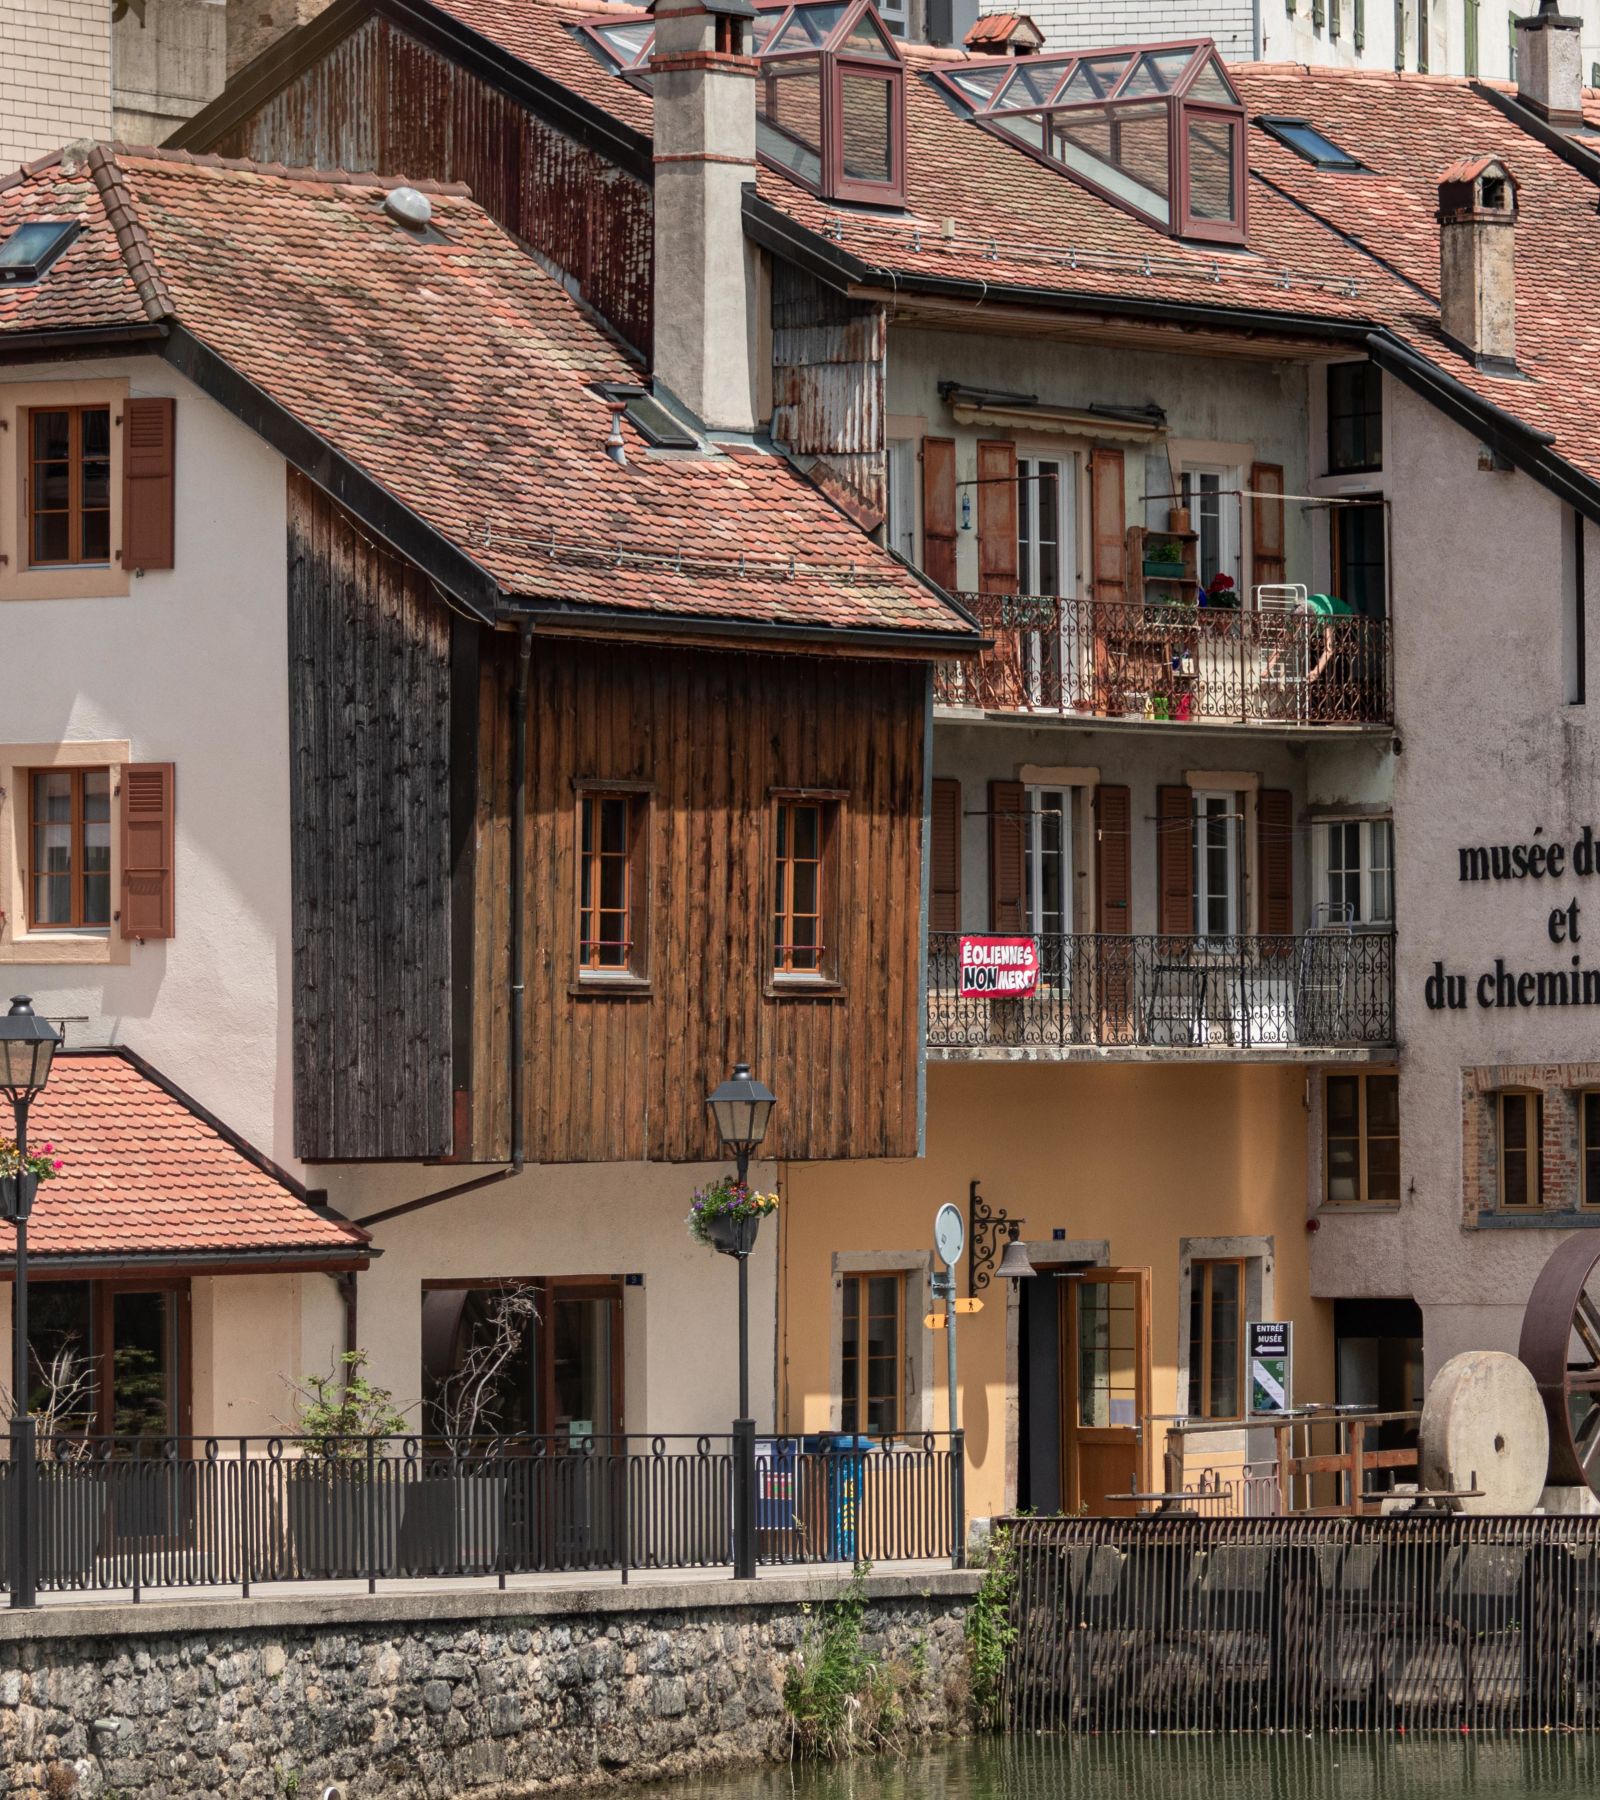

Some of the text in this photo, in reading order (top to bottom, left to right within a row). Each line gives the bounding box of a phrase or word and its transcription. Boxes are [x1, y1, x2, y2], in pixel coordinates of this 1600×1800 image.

[1458, 826, 1565, 882] musée
[1548, 896, 1581, 944] et
[962, 941, 1034, 966] ÉOLIENNES
[962, 966, 1036, 991] NON MERCI
[1424, 961, 1467, 1010] du
[1256, 1323, 1284, 1332] ENTRÉE
[1258, 1333, 1283, 1343] MUSÉE
